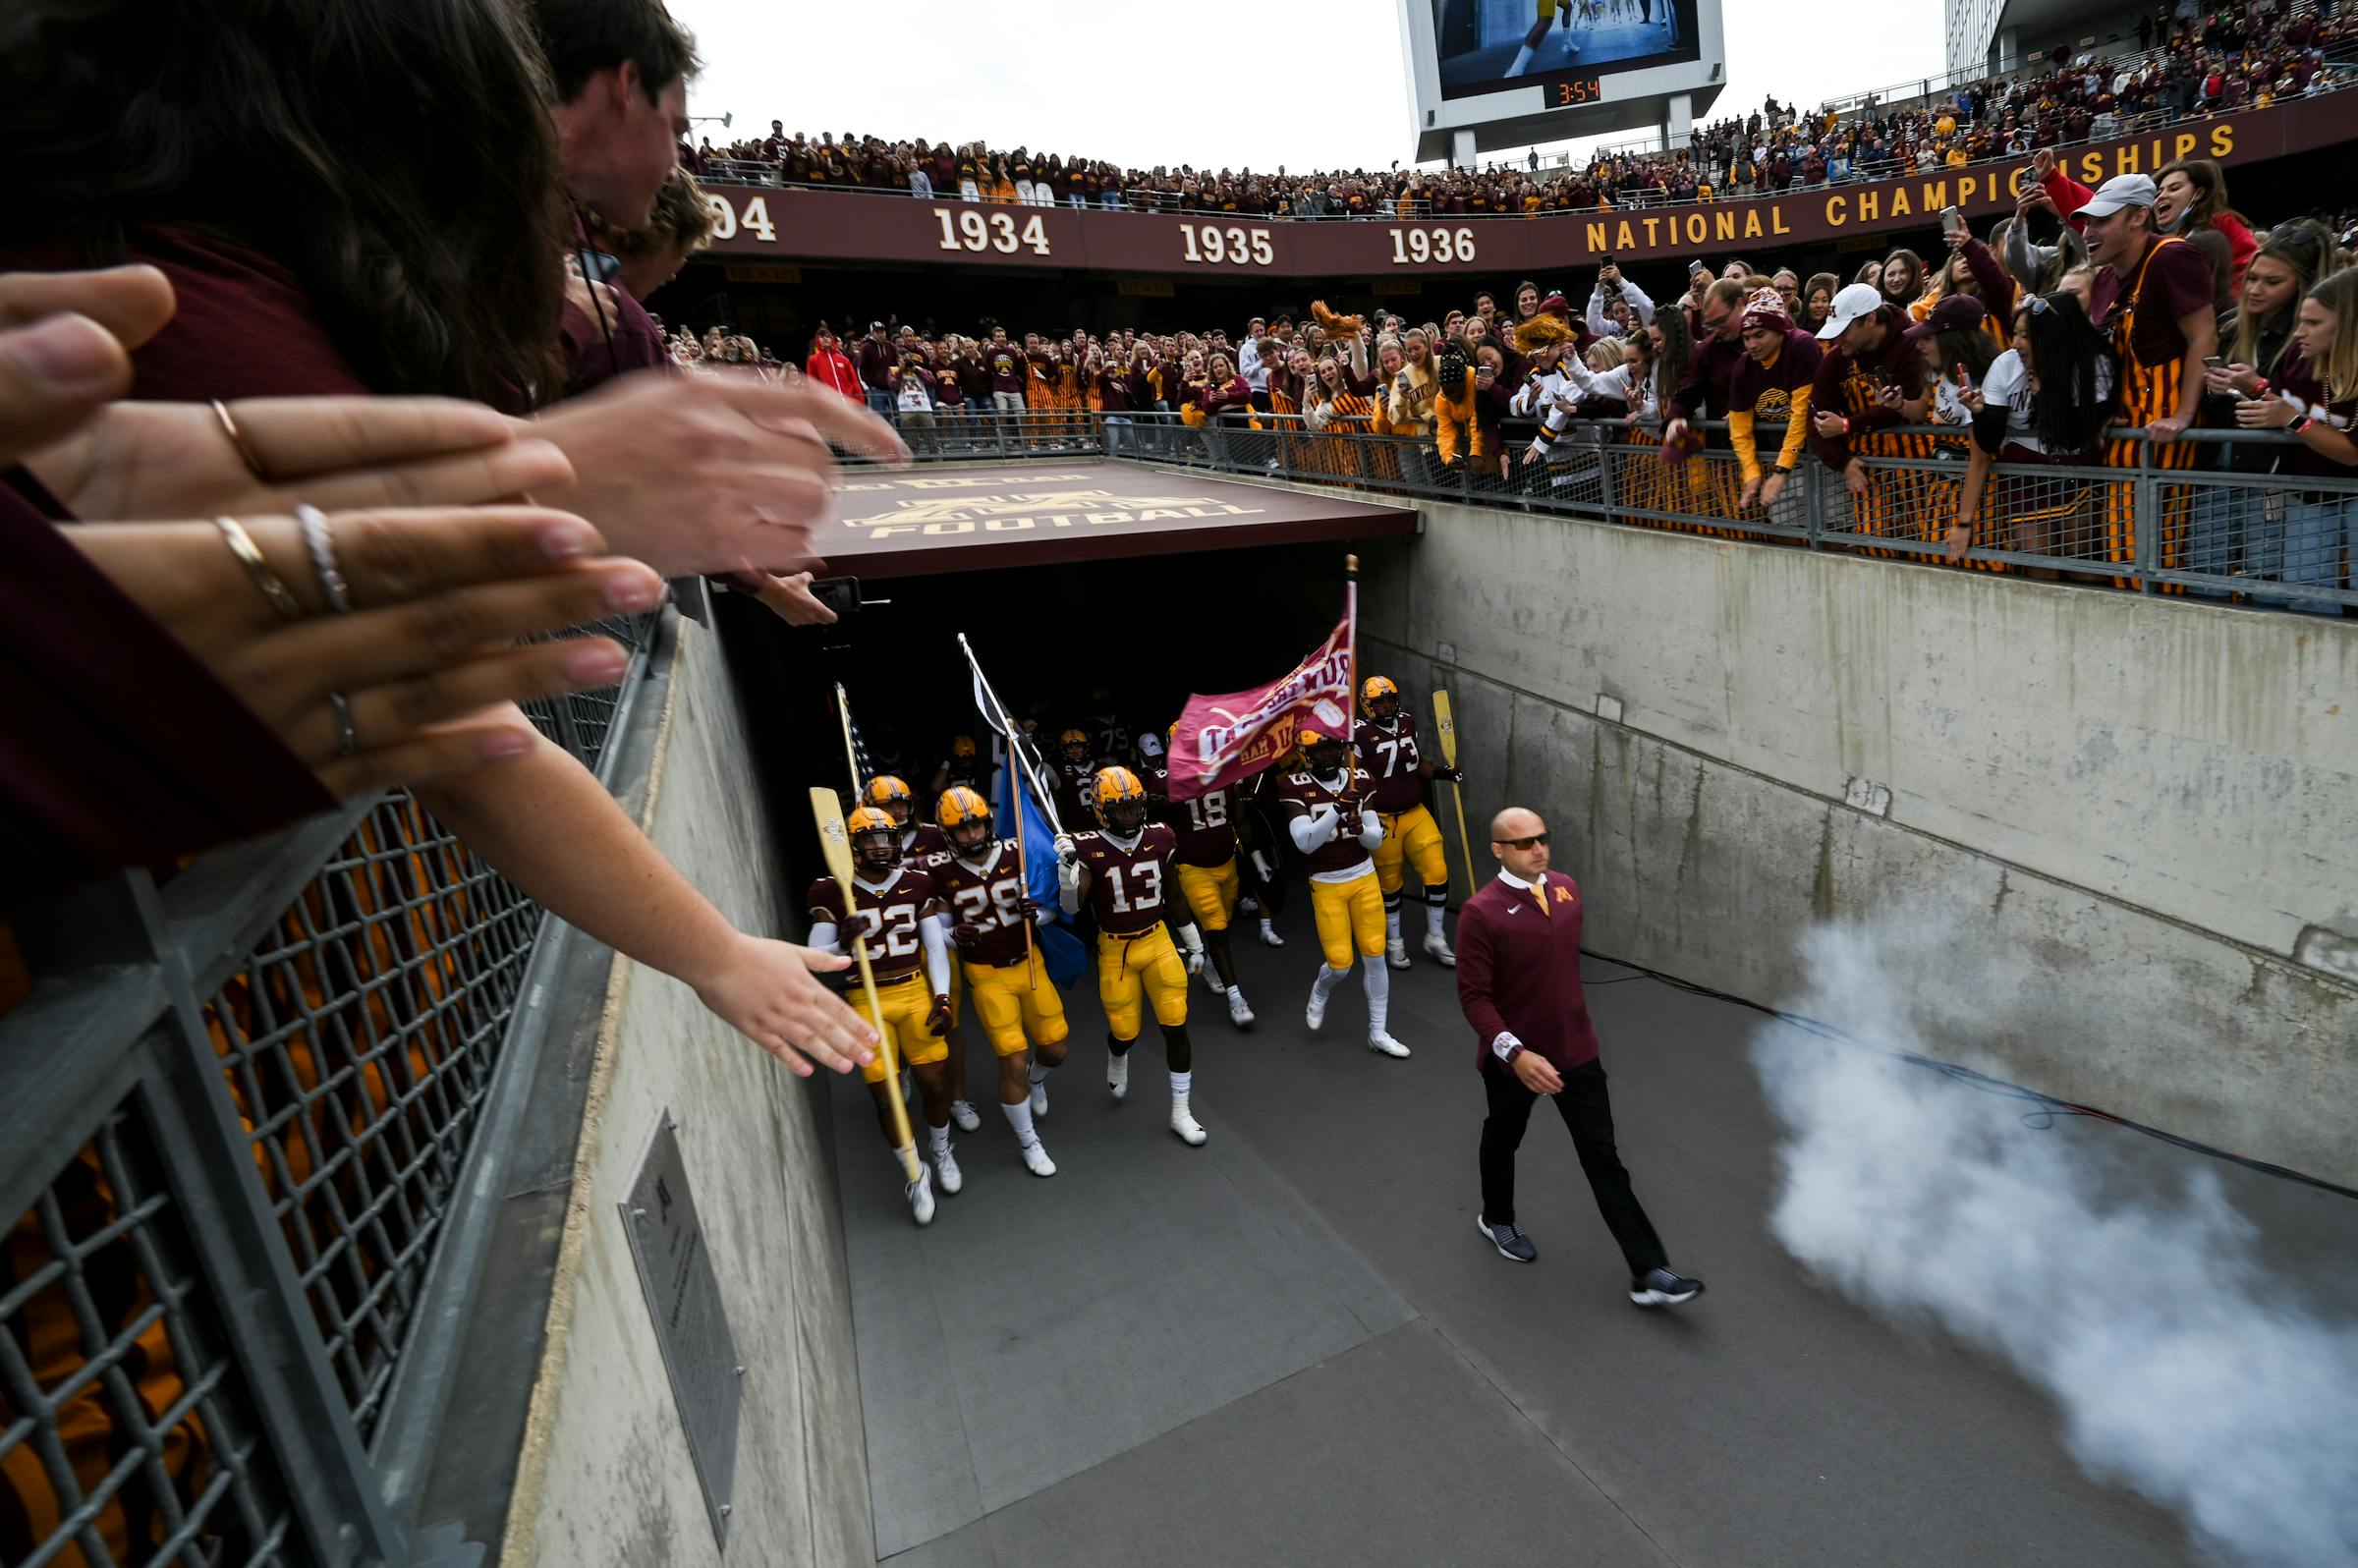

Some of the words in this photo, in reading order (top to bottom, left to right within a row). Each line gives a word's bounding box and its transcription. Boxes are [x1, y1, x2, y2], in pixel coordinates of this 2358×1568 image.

[1559, 80, 1600, 104] 3:54
[933, 207, 1050, 255] 1934
[1180, 224, 1274, 266] 1935
[1389, 227, 1476, 264] 1936
[1586, 205, 1791, 252] NATIONAL
[870, 503, 1265, 539] FOOTBALL
[1376, 736, 1420, 779] 73
[1184, 790, 1227, 831] 18
[953, 877, 1022, 934] 28
[1104, 859, 1163, 914] 13
[852, 903, 920, 962] 22
